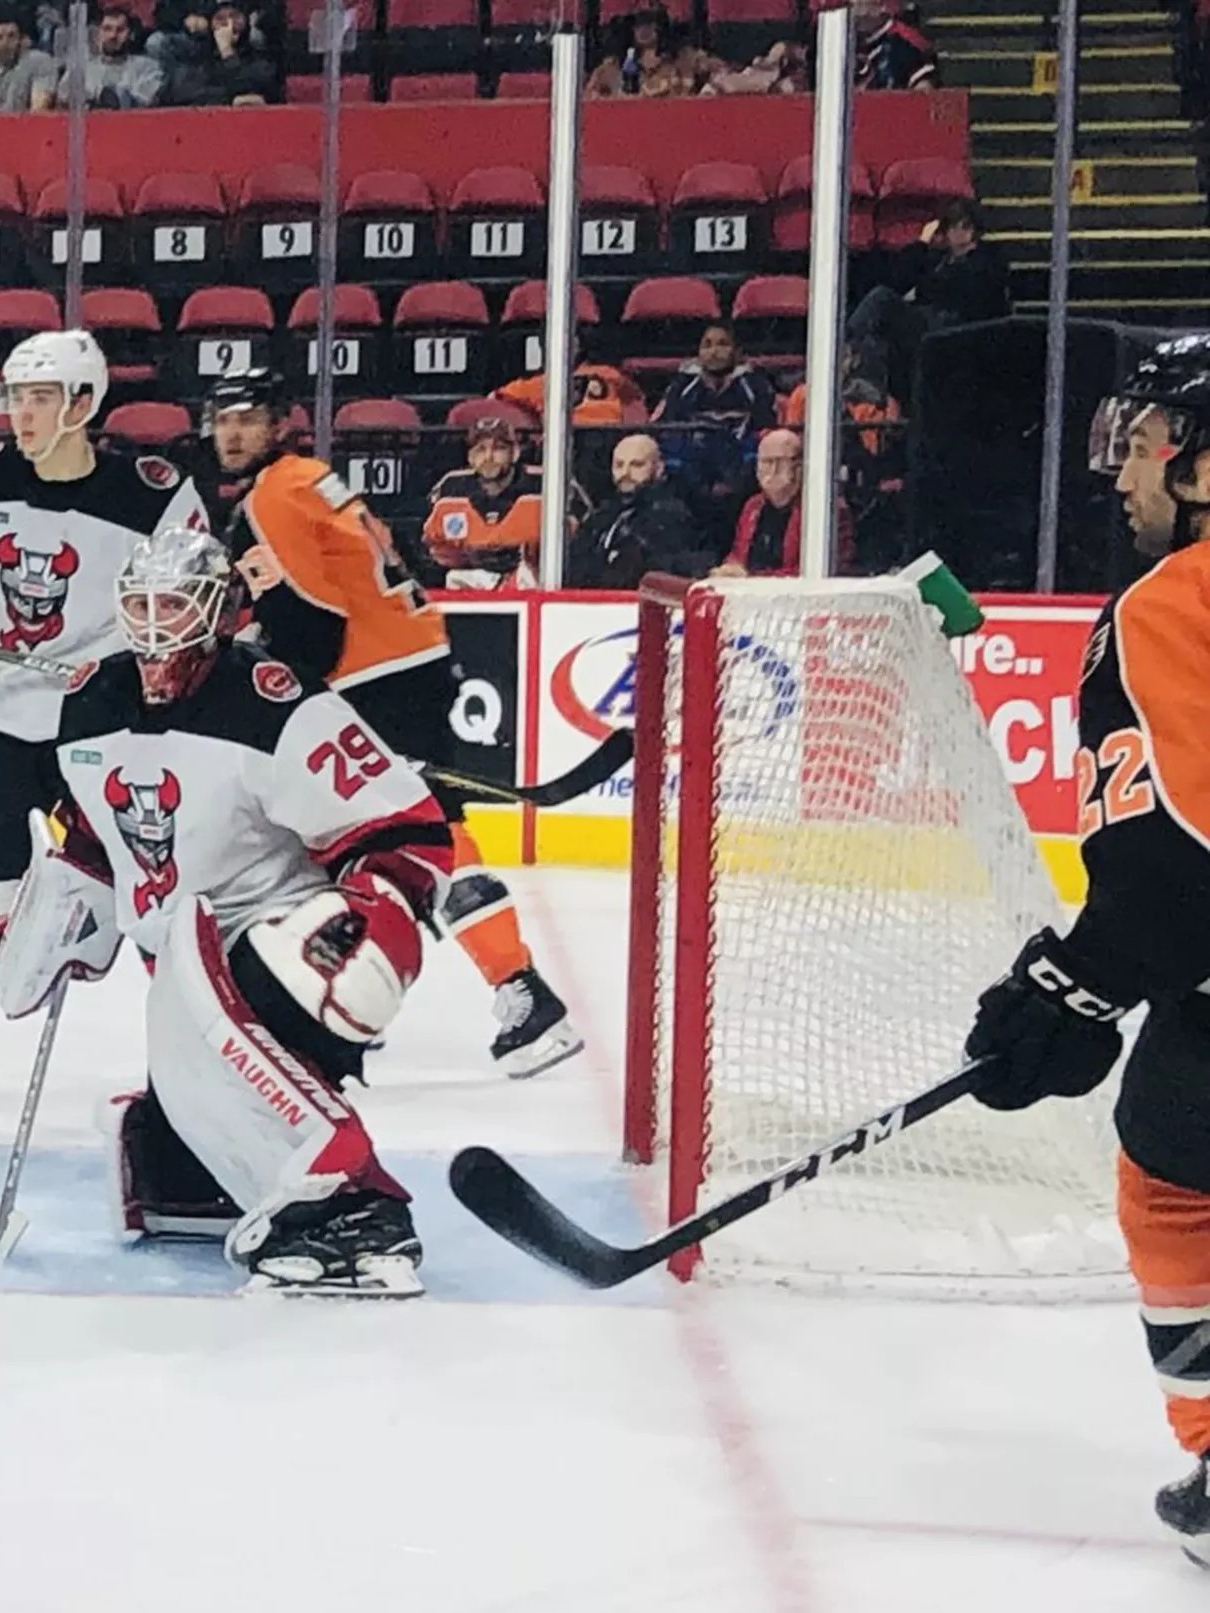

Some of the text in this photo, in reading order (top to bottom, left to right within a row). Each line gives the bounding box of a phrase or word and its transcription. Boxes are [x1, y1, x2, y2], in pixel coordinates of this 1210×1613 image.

[169, 228, 188, 256] 8
[278, 226, 295, 253] 9
[376, 225, 402, 253] 10
[484, 222, 509, 251] 11
[594, 220, 625, 249] 12
[707, 217, 735, 247] 13
[216, 343, 234, 369] 9
[427, 339, 452, 369] 11
[307, 722, 390, 801] 29
[219, 1036, 309, 1128] VAUGHN
